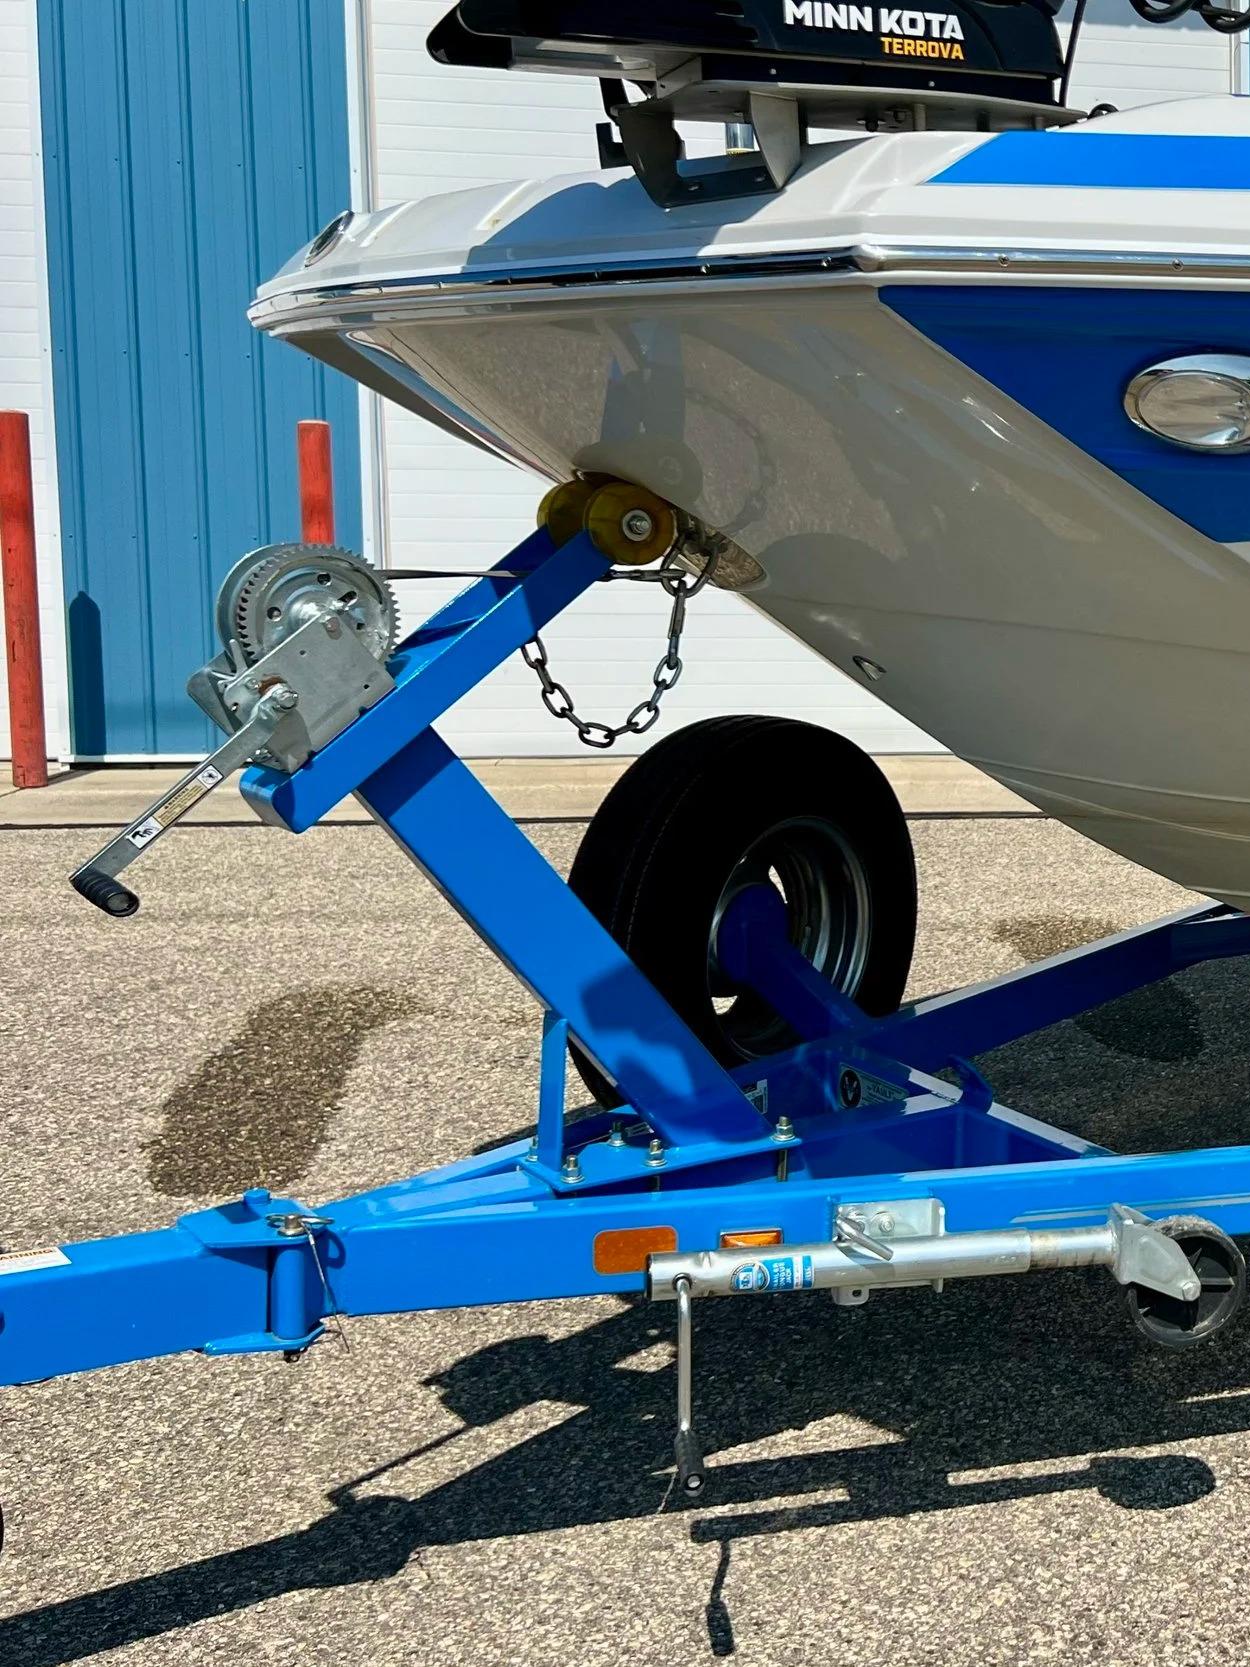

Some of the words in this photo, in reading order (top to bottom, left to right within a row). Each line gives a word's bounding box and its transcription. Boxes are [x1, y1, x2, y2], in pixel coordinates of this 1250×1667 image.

[783, 0, 873, 32] MINN
[879, 8, 965, 41] KOTA
[880, 37, 964, 60] TERROVA
